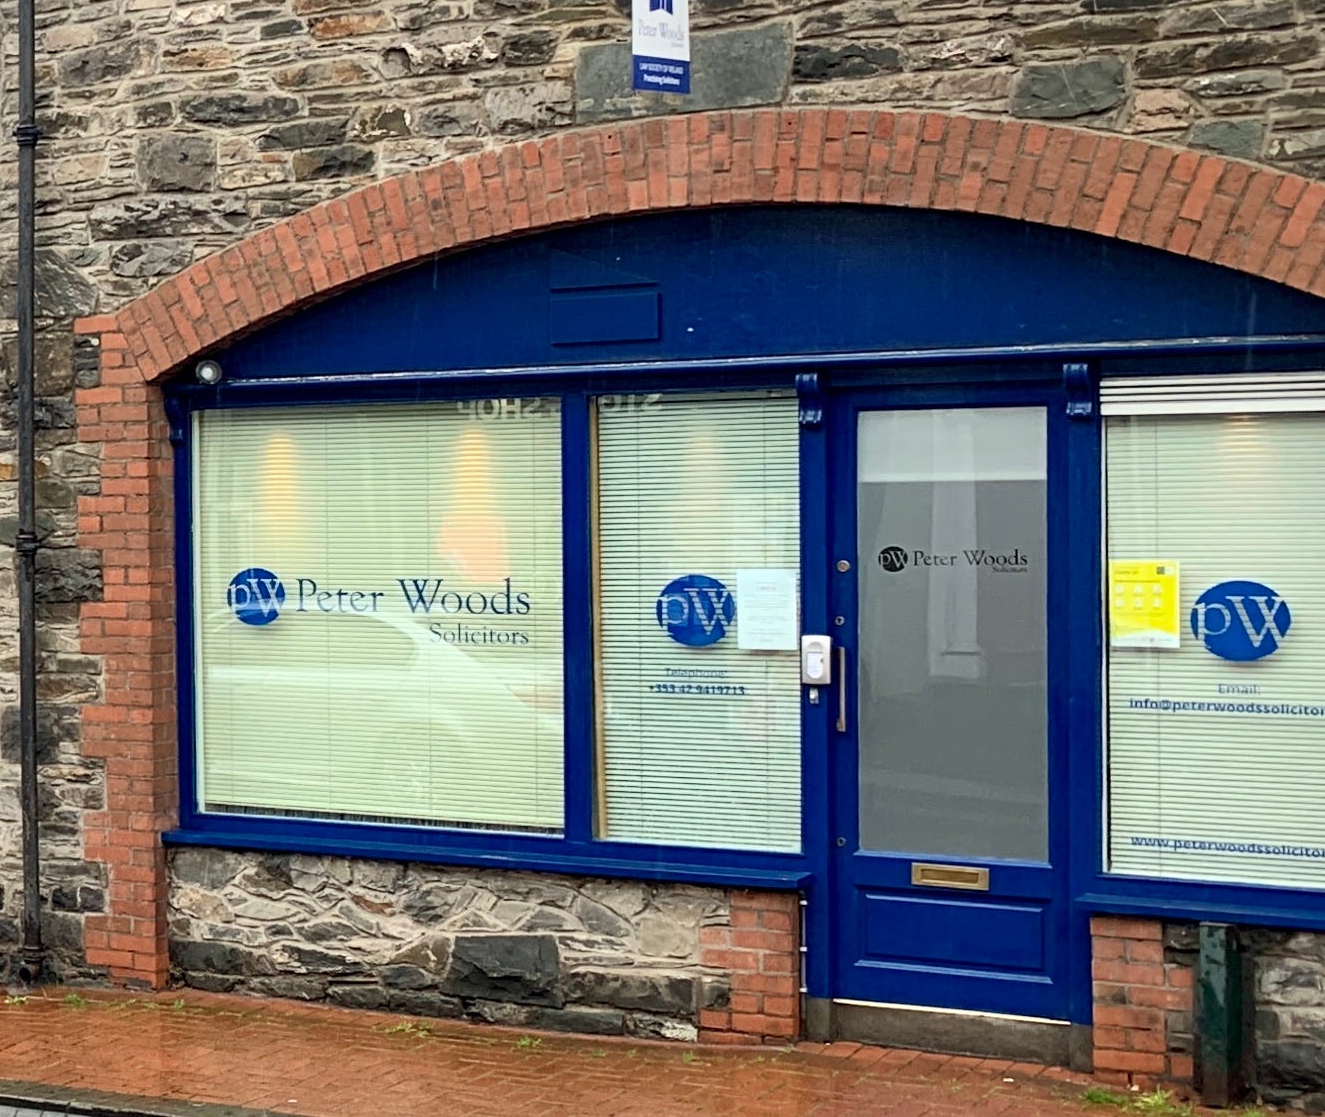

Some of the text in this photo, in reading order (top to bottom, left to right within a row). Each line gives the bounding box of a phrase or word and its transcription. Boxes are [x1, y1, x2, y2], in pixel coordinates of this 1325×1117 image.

[913, 548, 1028, 567] Peter Woods
[295, 577, 531, 616] Peter Woods
[429, 622, 531, 645] Solicitors
